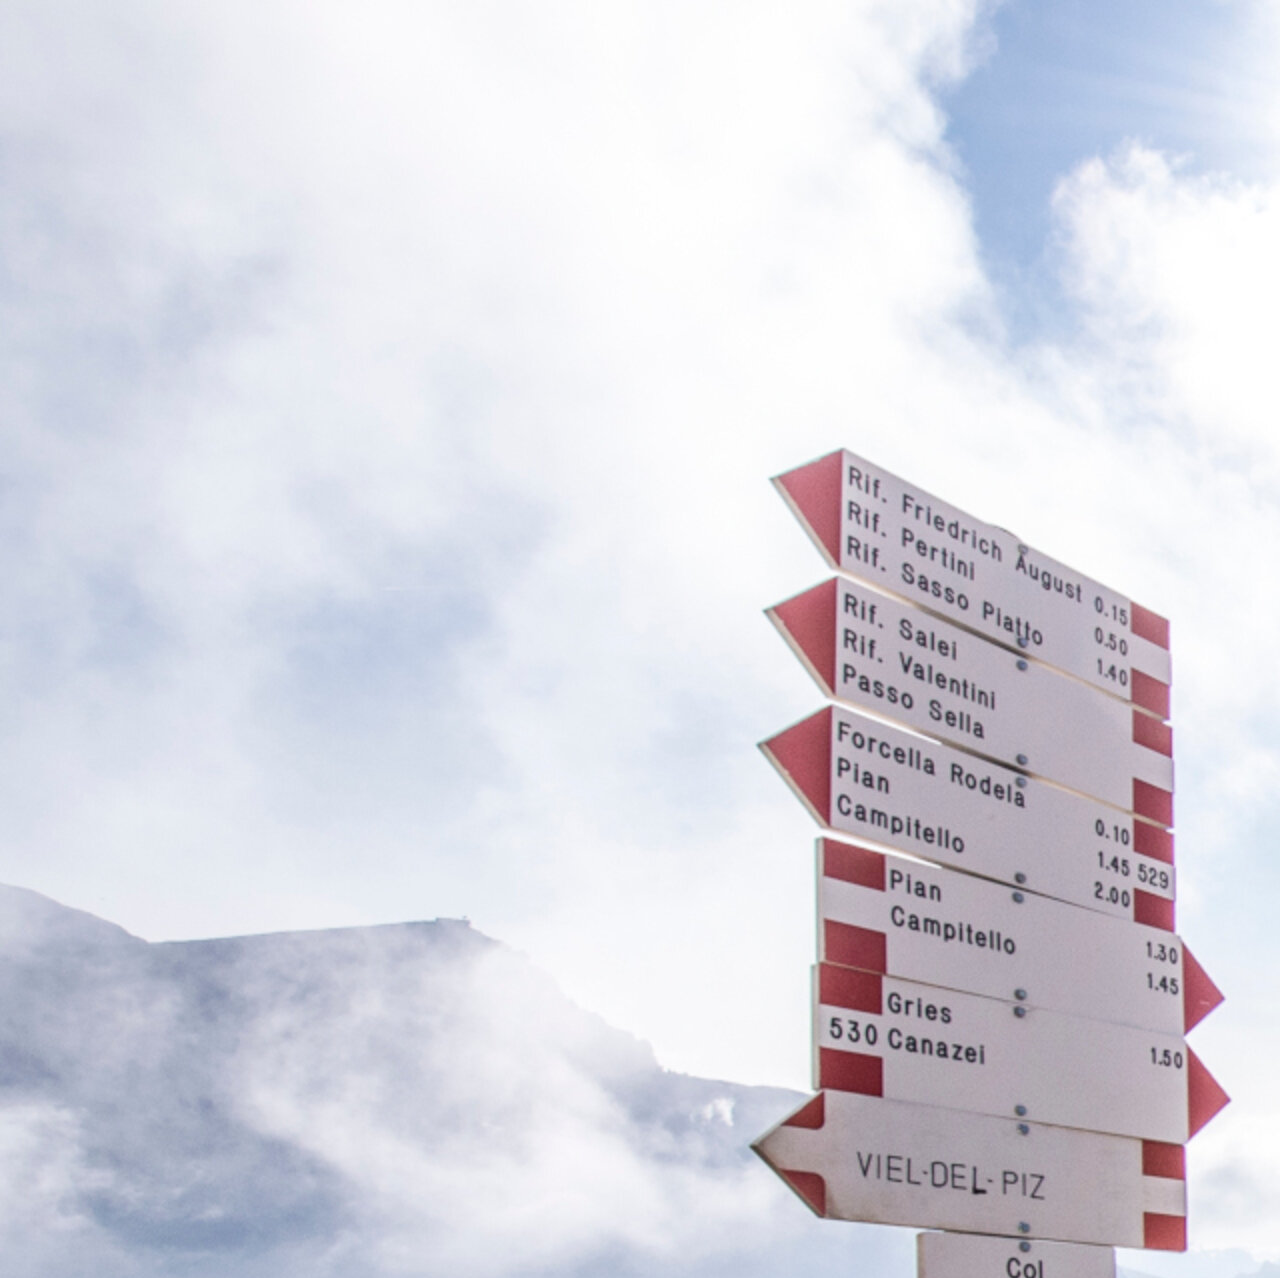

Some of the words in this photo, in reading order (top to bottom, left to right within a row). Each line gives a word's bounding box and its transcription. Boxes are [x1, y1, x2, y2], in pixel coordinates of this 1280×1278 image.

[847, 500, 887, 538] Rif.
[901, 527, 975, 581] Pertini
[1094, 626, 1128, 656] 0.50
[848, 465, 888, 503] Rif.
[901, 493, 1003, 562] Friedrich
[1015, 553, 1082, 603] August
[1093, 596, 1128, 626] 0.15
[843, 593, 884, 629] Rif.
[899, 618, 958, 661] Salei
[846, 535, 887, 572] Rif.
[901, 563, 969, 611] Sasso
[982, 601, 1044, 646] Piatto
[1096, 658, 1128, 687] 1.40
[842, 663, 915, 710] Passo
[928, 699, 985, 739] Sella
[843, 628, 884, 663] Rif.
[898, 651, 996, 710] Valentini
[837, 720, 936, 776] Forcella
[950, 763, 1027, 808] Rodela
[1094, 819, 1130, 846] 0.10
[837, 757, 890, 795] Pian
[1097, 851, 1131, 878] 1.45
[1137, 863, 1170, 890] 529
[836, 793, 966, 854] Campitello
[1094, 882, 1131, 908] 2.00
[889, 869, 942, 903] Pian
[1145, 941, 1178, 965] 1.30
[890, 906, 1017, 956] Campitello
[1146, 973, 1179, 995] 1.45
[829, 1017, 879, 1046] 530
[887, 1029, 986, 1065] Canazei
[887, 991, 953, 1024] Gries
[1149, 1047, 1183, 1070] 1.50
